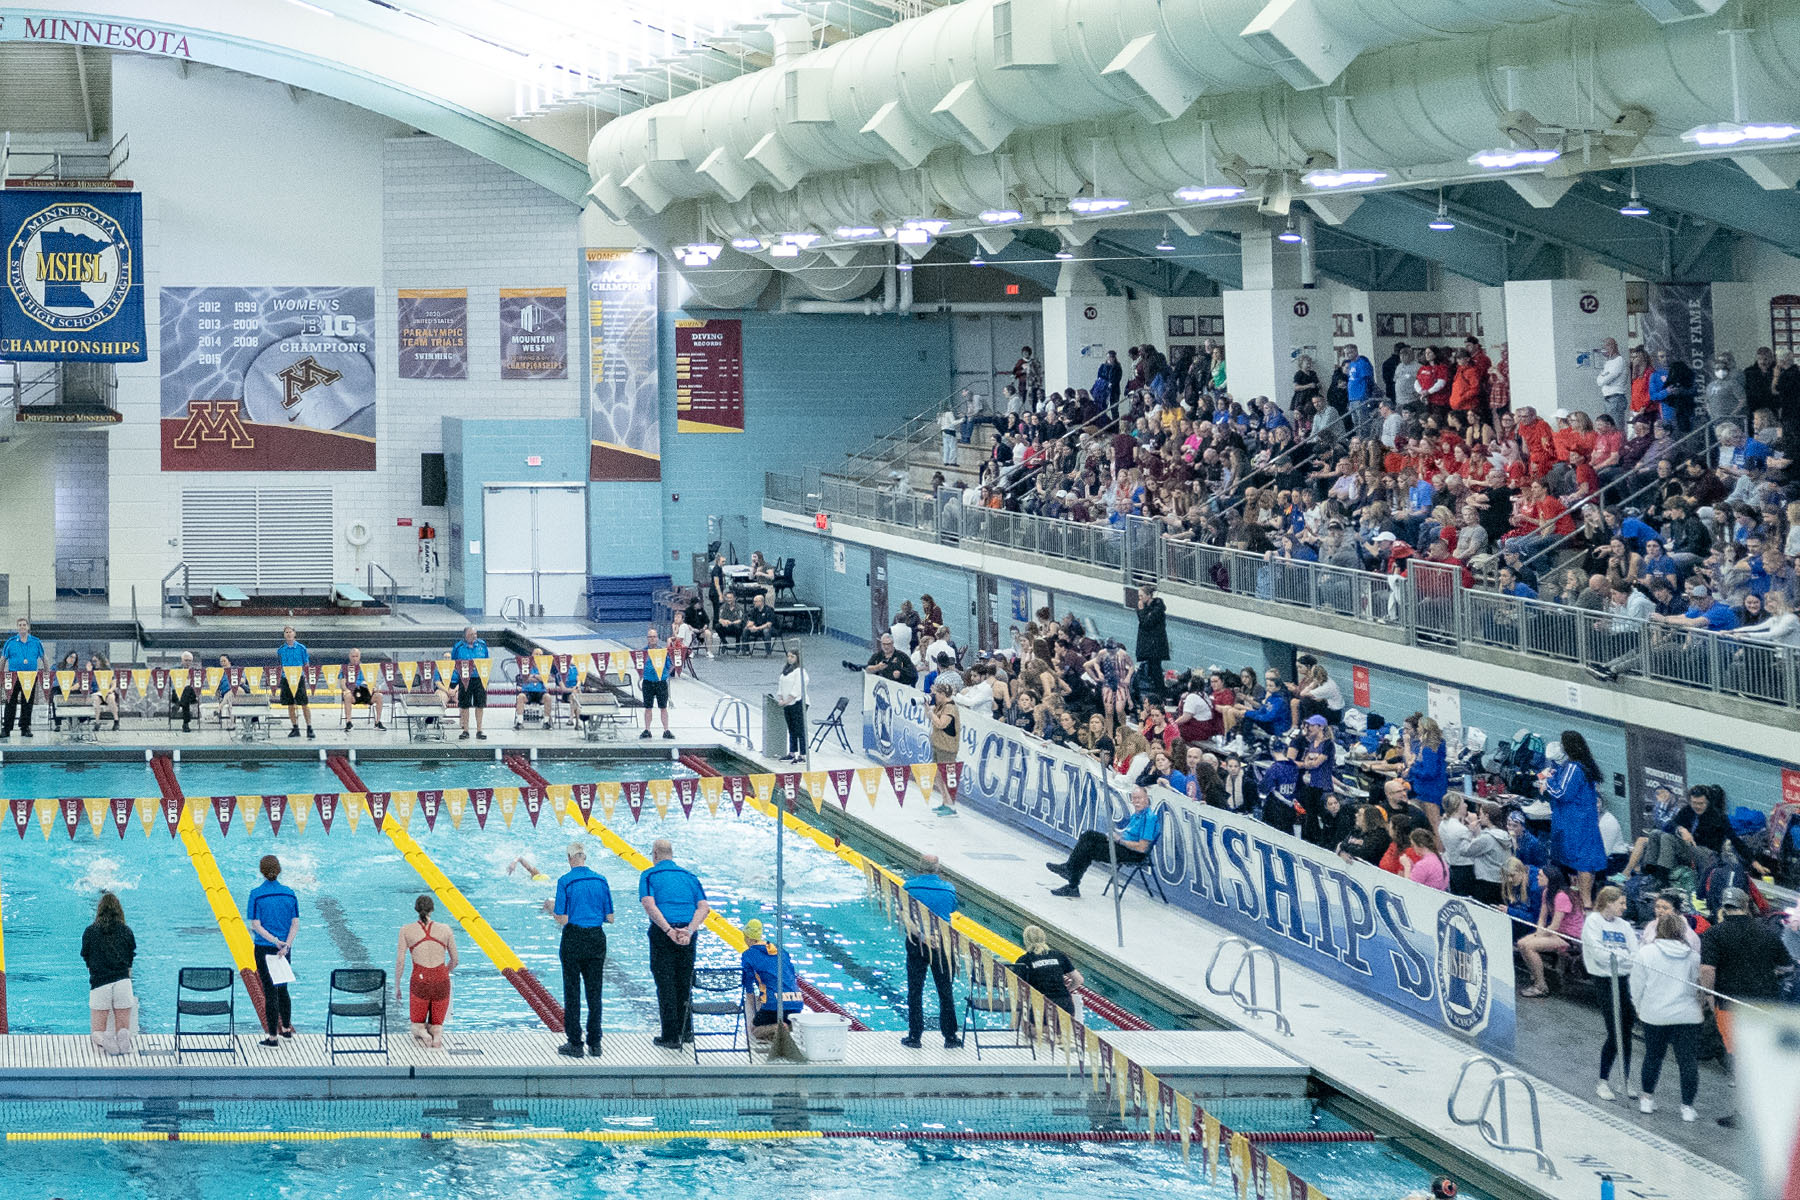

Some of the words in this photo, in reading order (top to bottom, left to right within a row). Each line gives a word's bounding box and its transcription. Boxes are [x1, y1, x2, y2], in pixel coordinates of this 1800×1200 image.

[23, 17, 193, 59] MINNESOTA
[28, 207, 116, 236] MINNESOTA
[36, 252, 107, 283] MSHSL
[11, 260, 26, 303] STATE
[24, 299, 55, 325] HIGH
[58, 311, 108, 327] SCHOOL
[198, 302, 221, 312] 2012
[272, 299, 340, 311] WOMEN'S
[1296, 303, 1306, 315] 11
[1582, 297, 1598, 311] 12
[1085, 308, 1097, 318] 10
[198, 319, 221, 330] 2013
[1689, 299, 1703, 343] FAME
[403, 328, 463, 337] PARALYMPIC
[198, 336, 221, 347] 2014
[402, 338, 429, 347] TEAM
[430, 338, 464, 347] TRIALS
[511, 335, 555, 344] MOUNTAIN
[0, 339, 140, 354] CHAMPIONSHIPS
[279, 343, 367, 353] CHAMPIONS
[522, 344, 545, 352] WEST
[198, 353, 222, 364] 2015
[414, 352, 453, 360] SWIMMING
[23, 413, 65, 422] UNIVERSITY
[76, 414, 117, 422] MINNESOTA
[173, 401, 254, 449] M
